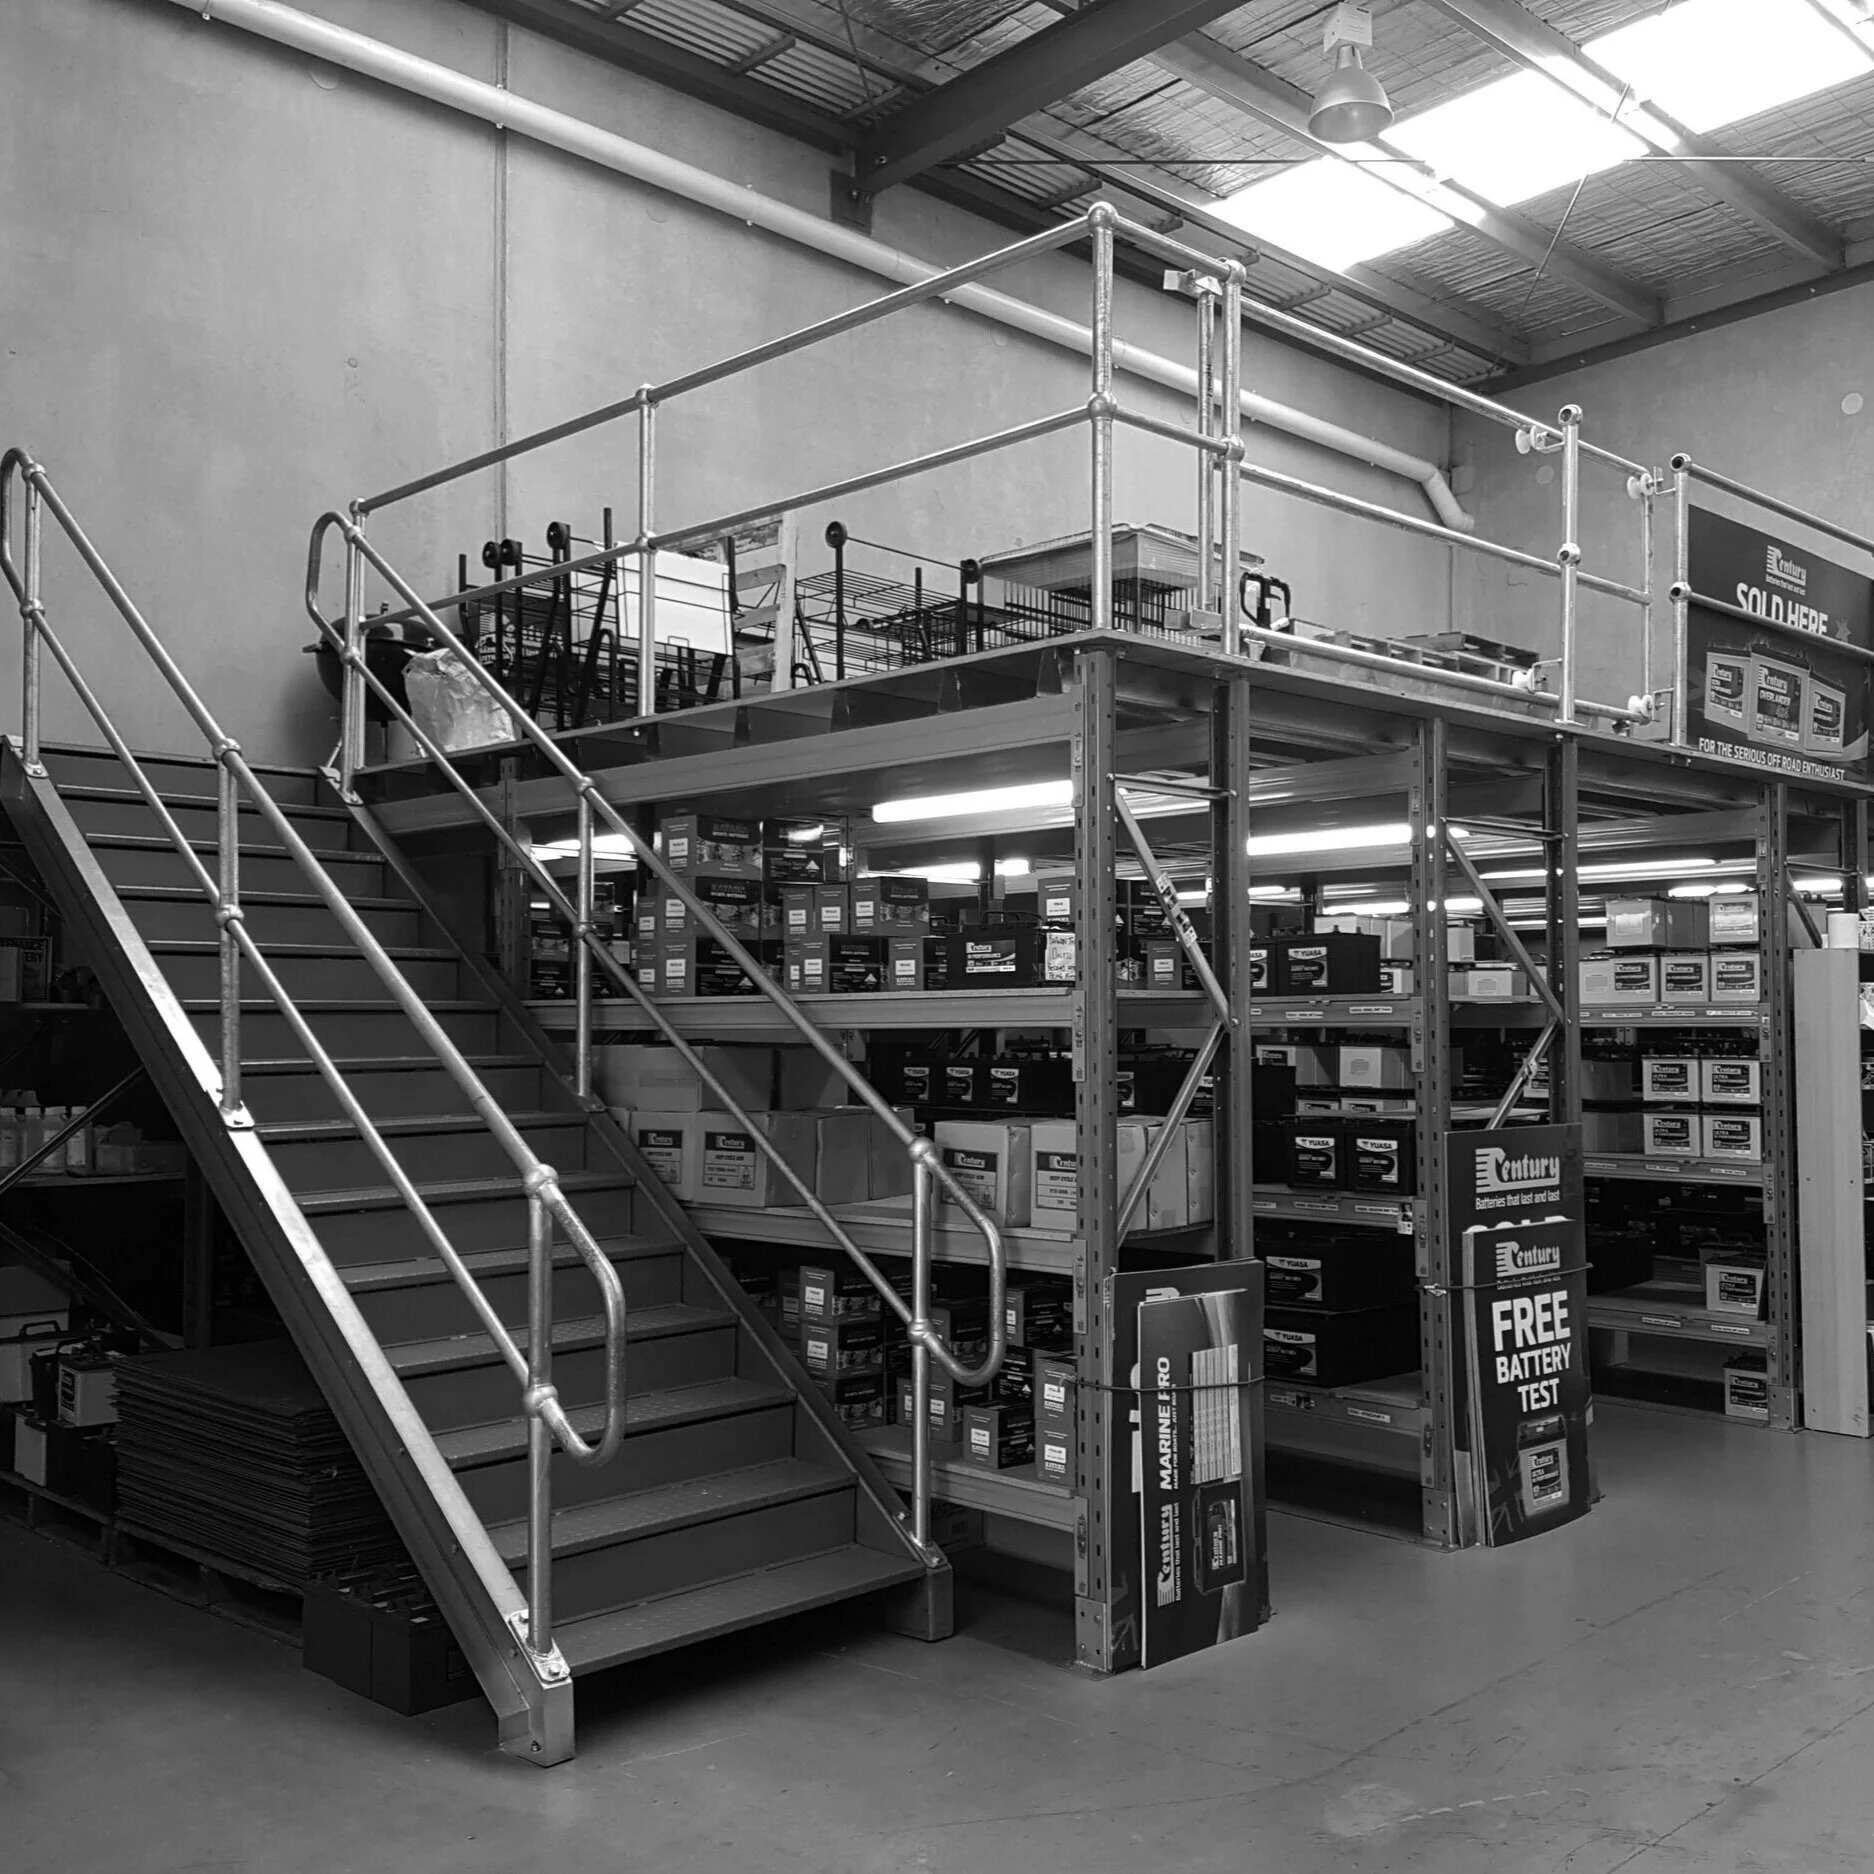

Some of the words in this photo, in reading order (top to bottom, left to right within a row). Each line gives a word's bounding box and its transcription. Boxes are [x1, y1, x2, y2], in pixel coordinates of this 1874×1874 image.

[1766, 545, 1807, 586] Century
[1787, 600, 1828, 635] HERE
[1699, 737, 1716, 752] FOR
[1717, 741, 1732, 756] THE
[1733, 744, 1766, 764] SERIOUS
[1767, 753, 1782, 768] OFF
[1782, 756, 1801, 772] ROAD
[1802, 760, 1846, 781] ENTHUSIAST
[1370, 1142, 1392, 1150] YUASA
[1475, 1147, 1560, 1193] Century
[1475, 1196, 1506, 1210] Batteries
[1506, 1193, 1520, 1207] that
[1521, 1192, 1534, 1205] last
[1534, 1190, 1547, 1203] and
[1548, 1189, 1560, 1202] last
[1287, 1260, 1308, 1268] YUASA
[1496, 1241, 1560, 1278] Century
[1492, 1290, 1571, 1352] FREE
[1157, 1357, 1172, 1401] PRO
[1496, 1342, 1571, 1384] BATTERY
[1517, 1378, 1559, 1412] TEST
[1158, 1405, 1172, 1490] MARINE
[1157, 1504, 1175, 1608] Century
